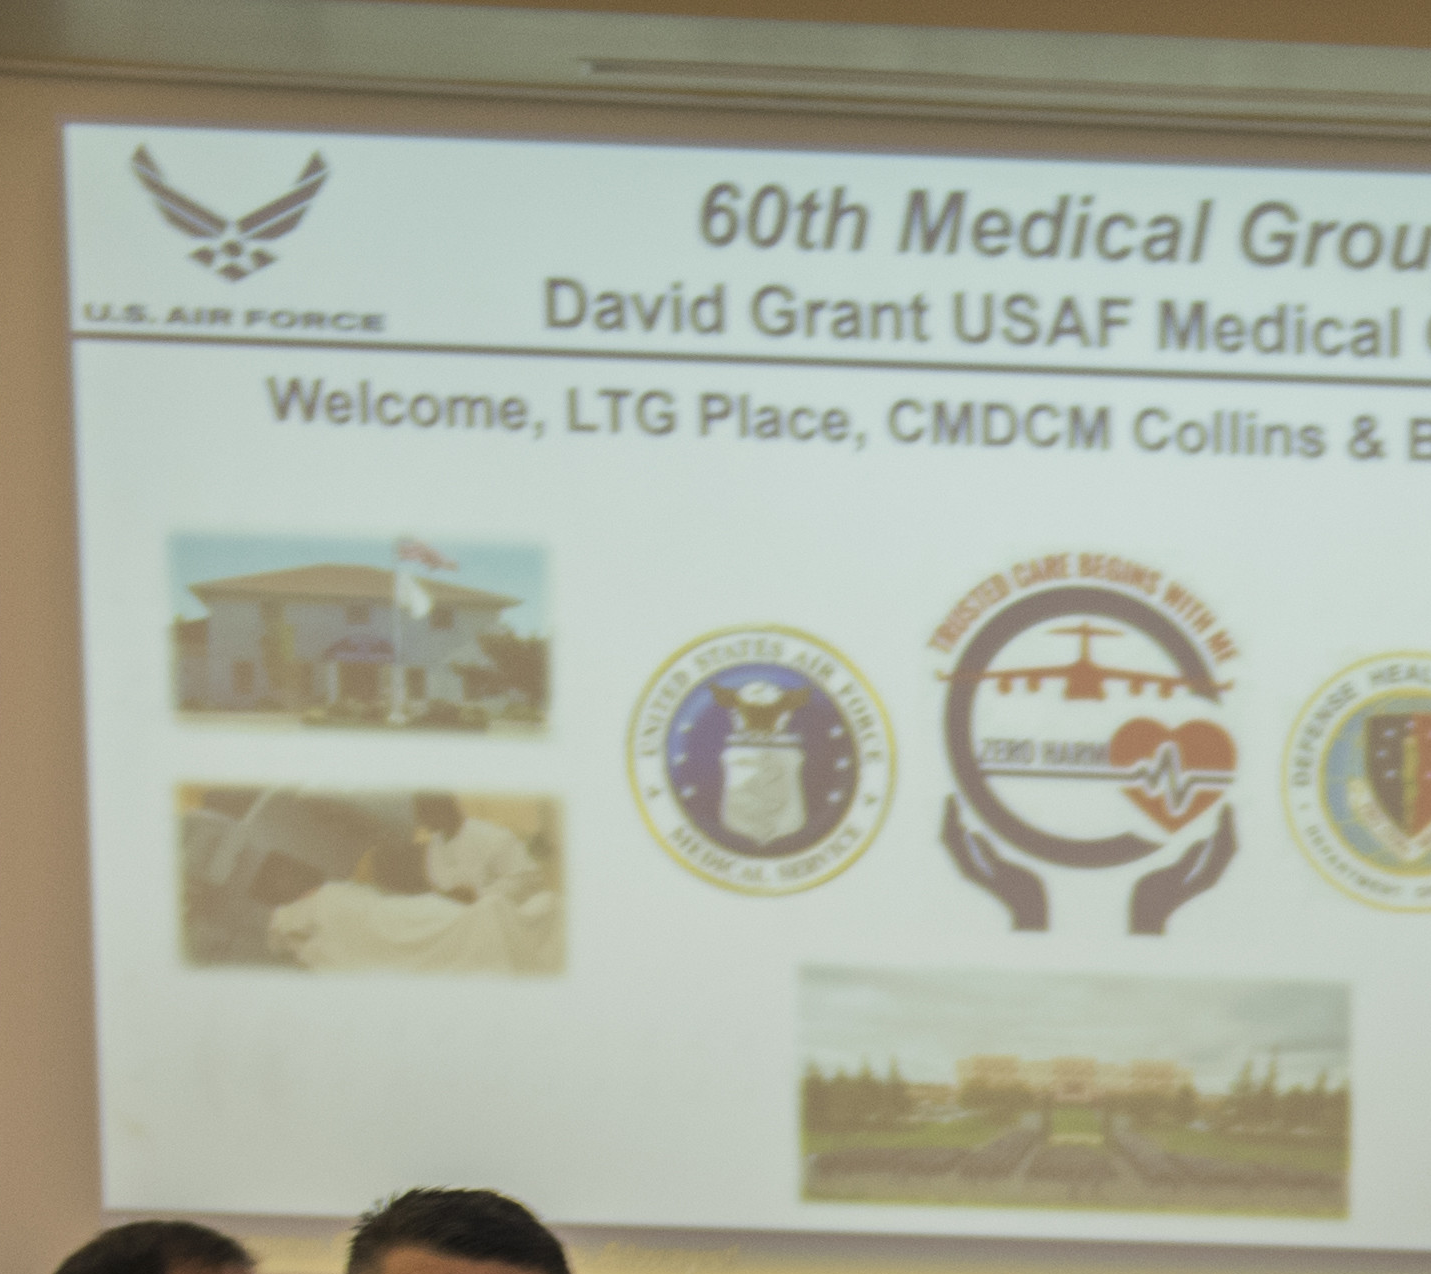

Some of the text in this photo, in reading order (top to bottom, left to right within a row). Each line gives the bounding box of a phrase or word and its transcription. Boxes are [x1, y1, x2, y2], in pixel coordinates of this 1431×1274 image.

[699, 181, 869, 254] 60th
[901, 190, 1210, 265] Medical
[82, 302, 385, 333] U.S. AIR FORCE
[543, 277, 726, 335] David
[751, 284, 930, 343] Grant
[951, 291, 1132, 349] USAF
[1156, 299, 1403, 360] Medical
[266, 374, 545, 441] Welcome,
[566, 387, 678, 435] LTG
[699, 392, 869, 451] Place,
[888, 397, 1112, 451] CMDCM
[1132, 404, 1329, 461] Collins
[1348, 414, 1386, 461] &
[928, 553, 1240, 664] TRUSTED CARE BEGINS WITH ME
[641, 639, 884, 761] UNITED STATES AIR FORCE
[1291, 681, 1359, 788] DEFENSE
[977, 737, 1034, 765] ZERO
[671, 825, 861, 881] MEDICAL SERVICE
